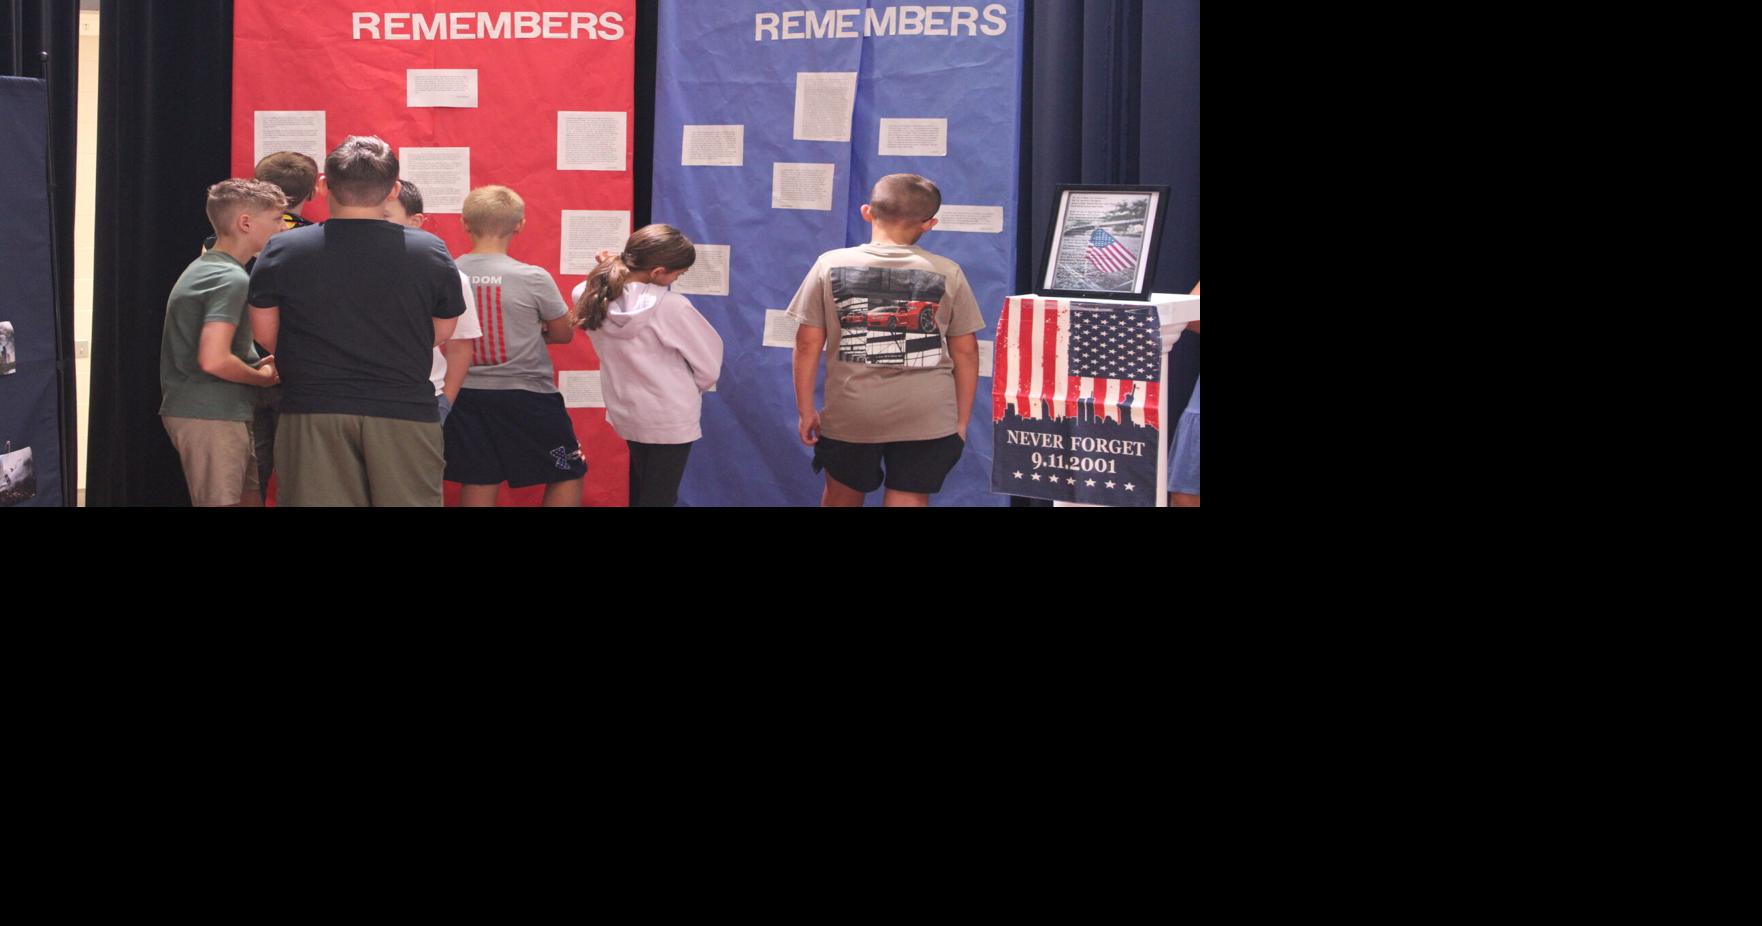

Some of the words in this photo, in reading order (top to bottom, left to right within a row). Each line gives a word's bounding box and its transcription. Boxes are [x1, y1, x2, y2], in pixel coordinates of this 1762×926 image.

[352, 11, 625, 41] REMEMBERS
[754, 3, 1007, 41] REMEMBERS
[468, 275, 503, 284] DOM
[1006, 429, 1065, 449] NEVER
[1070, 436, 1146, 457] FORGET
[1031, 452, 1117, 474] 9.11.2001
